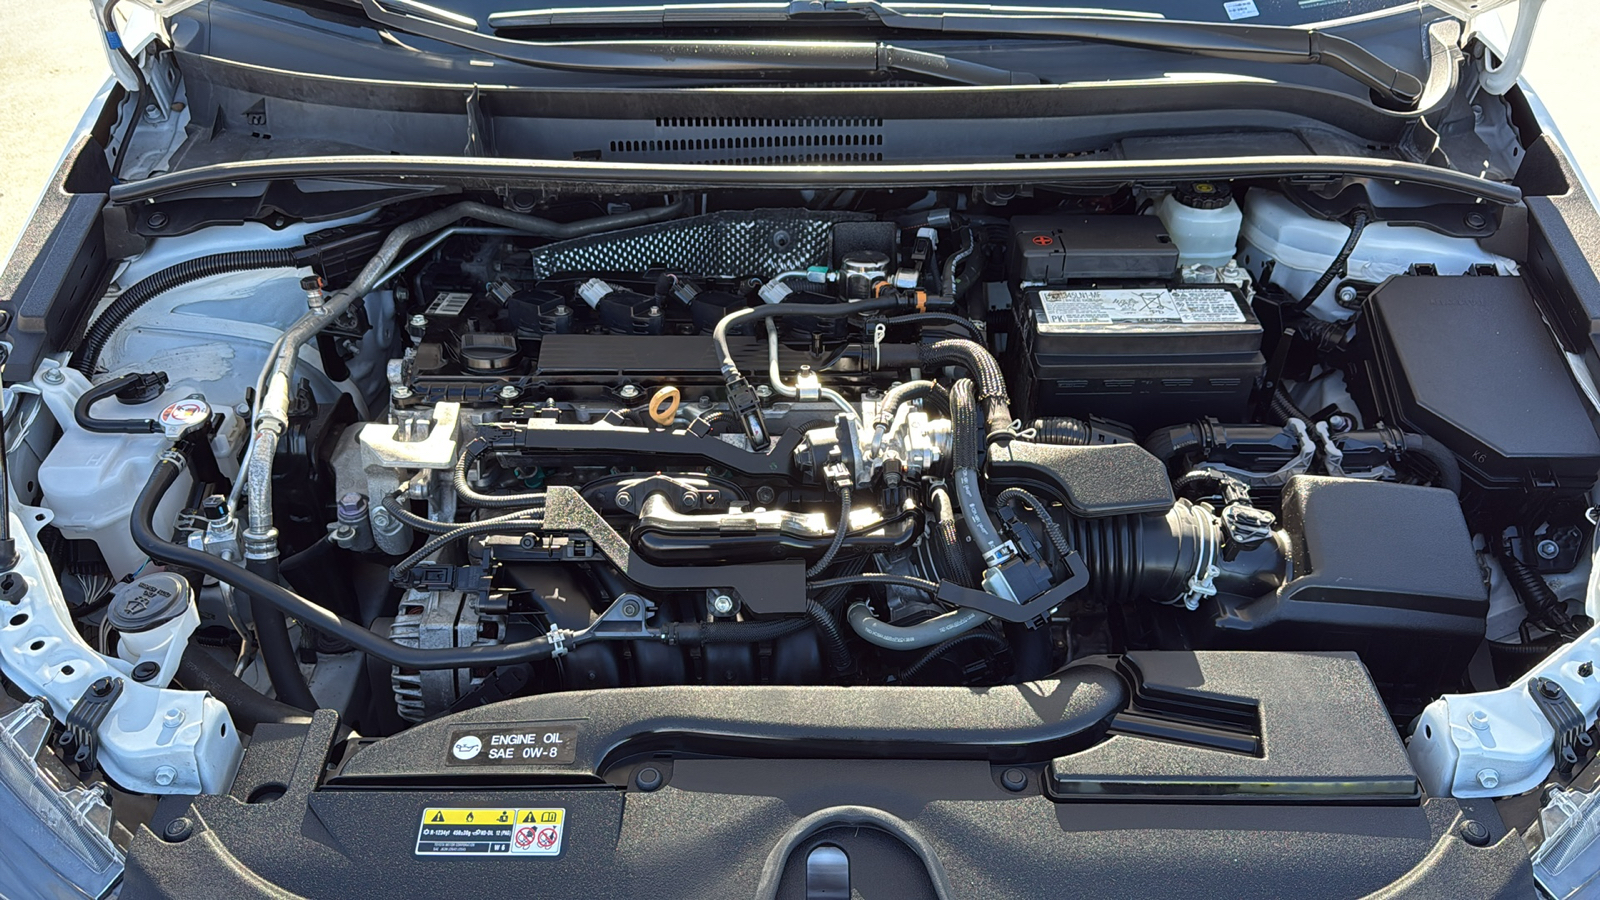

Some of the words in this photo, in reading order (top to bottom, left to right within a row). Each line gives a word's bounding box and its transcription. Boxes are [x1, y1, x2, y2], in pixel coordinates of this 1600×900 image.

[1051, 315, 1065, 323] PK
[491, 733, 536, 745] ENGINE
[543, 732, 563, 743] OIL
[488, 748, 514, 758] SAE
